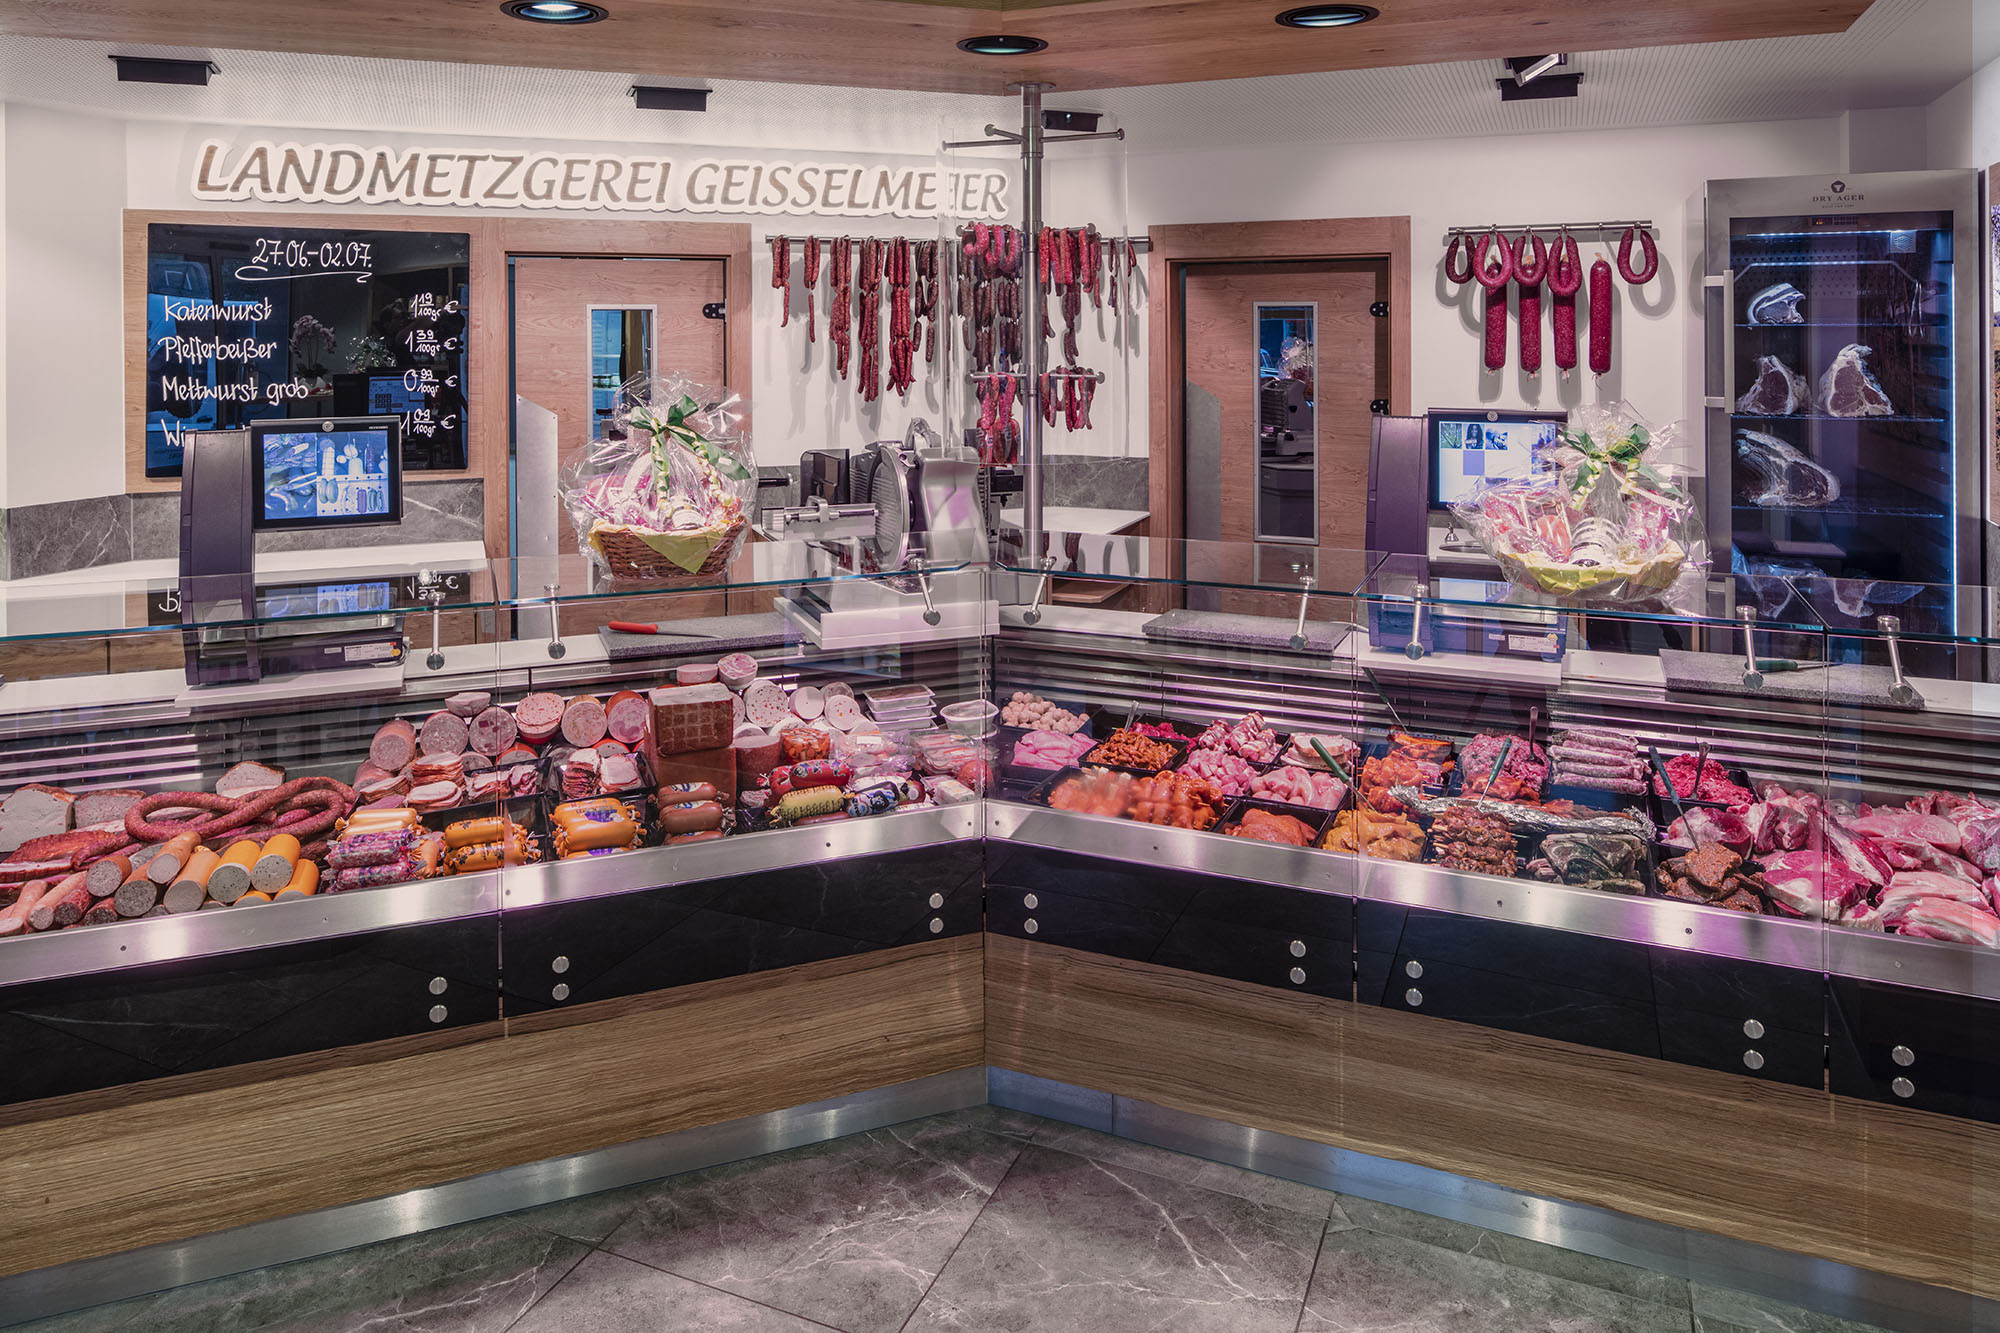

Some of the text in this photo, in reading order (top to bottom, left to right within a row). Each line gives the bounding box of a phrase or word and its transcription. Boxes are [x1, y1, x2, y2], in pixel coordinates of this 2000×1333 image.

[197, 144, 671, 204] LANDMETZGEREI
[165, 295, 273, 322] Katenwurst
[157, 335, 277, 365] Pfefferbeißer
[162, 375, 309, 406] Mettwurst grob
